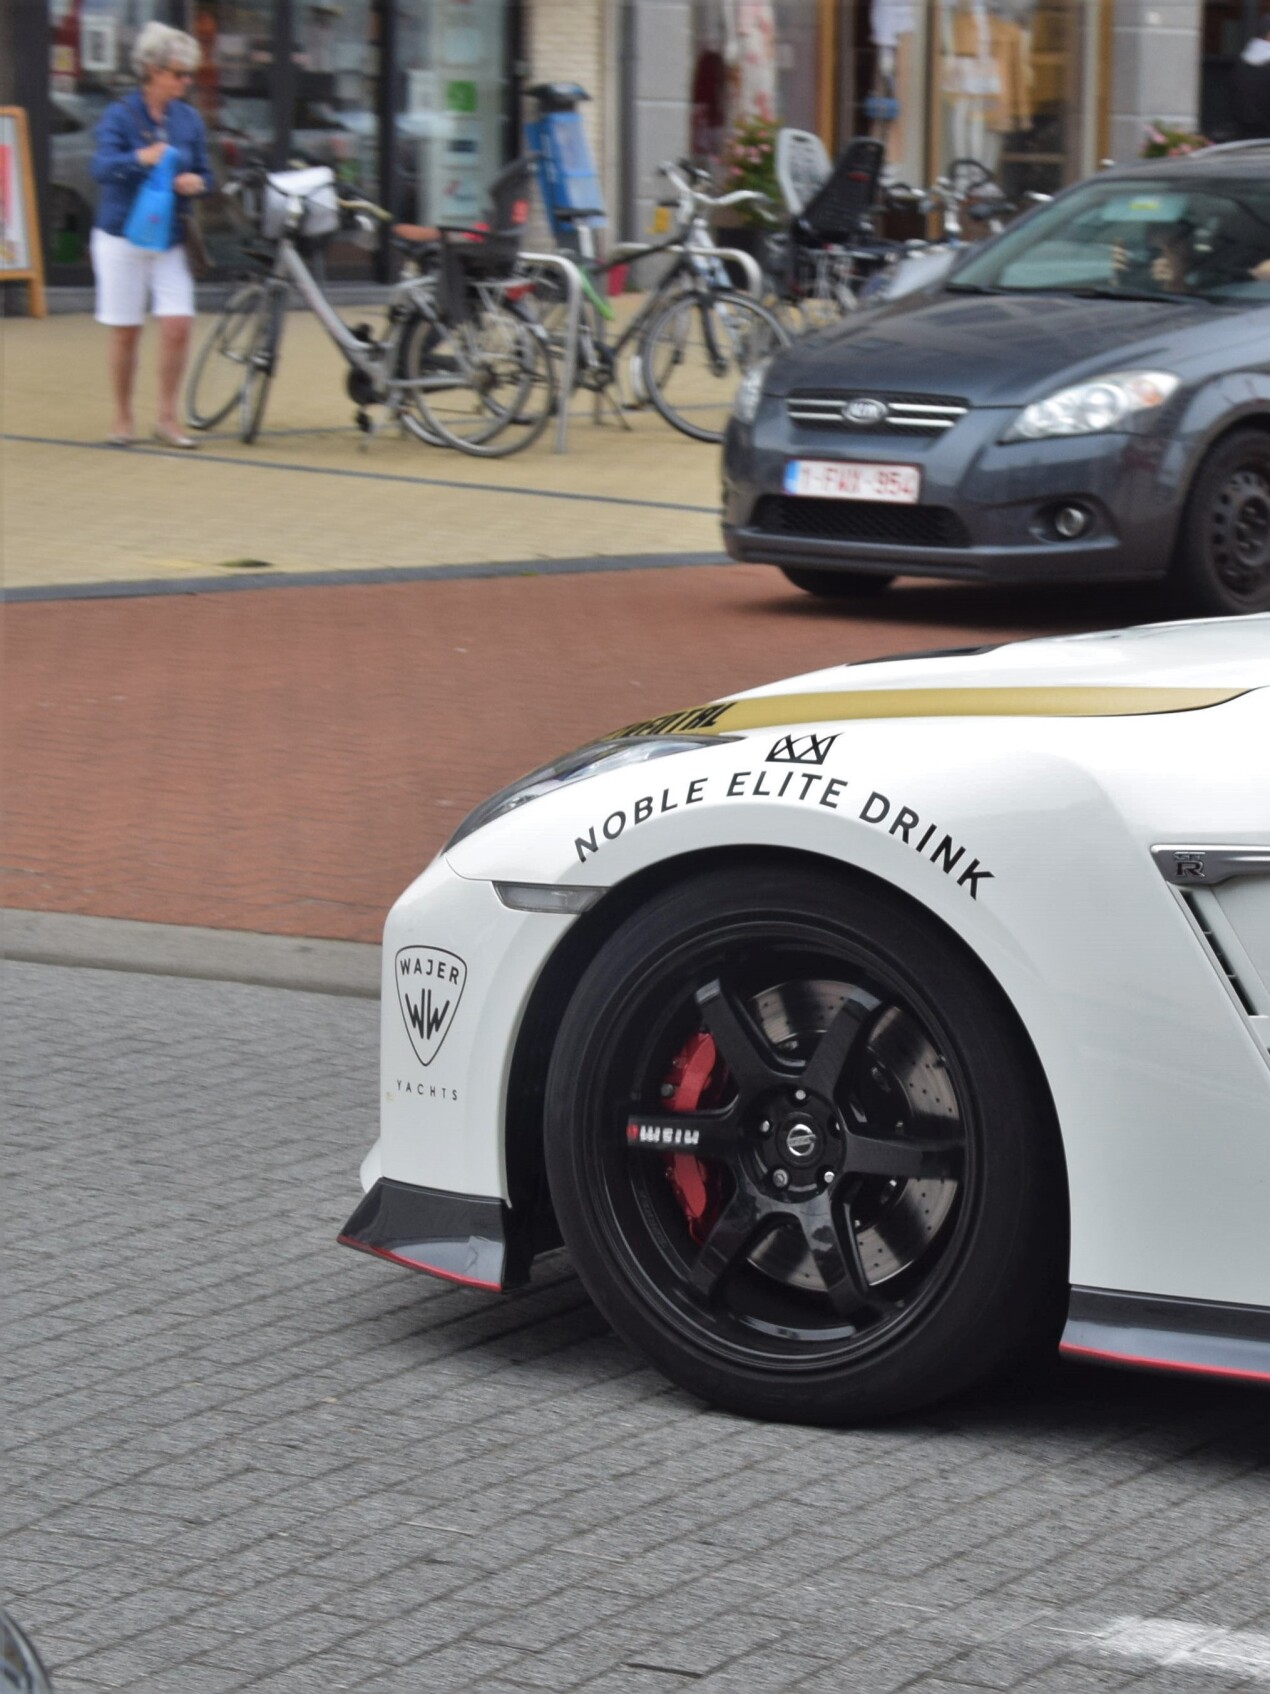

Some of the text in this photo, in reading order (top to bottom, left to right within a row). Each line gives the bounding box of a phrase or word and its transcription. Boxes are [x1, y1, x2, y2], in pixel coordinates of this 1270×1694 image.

[574, 771, 996, 900] NOBLE ELITE DRINK
[400, 957, 460, 985] WAJER
[397, 1079, 458, 1101] YACHTS
